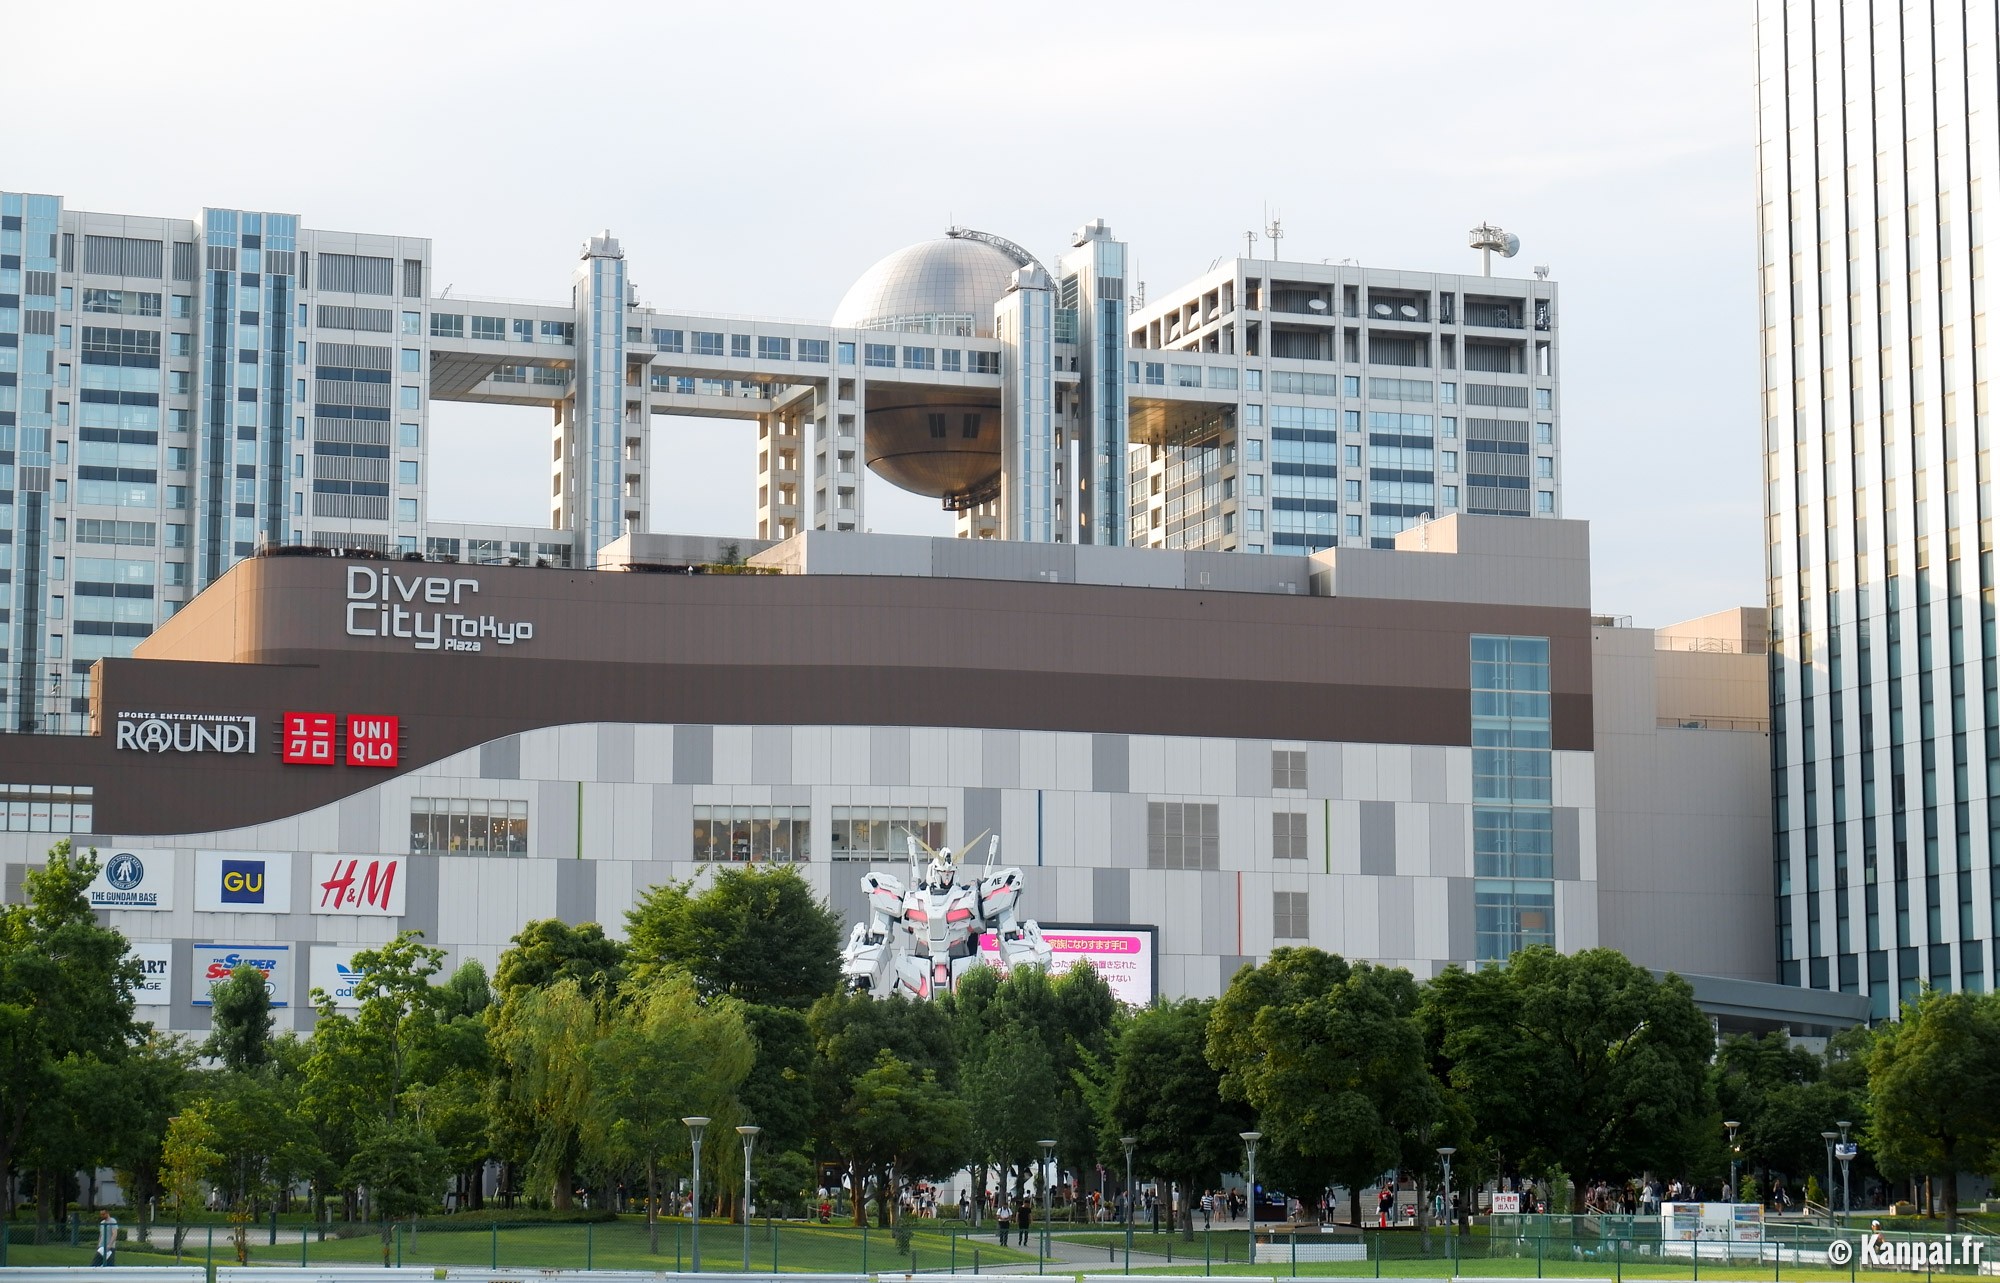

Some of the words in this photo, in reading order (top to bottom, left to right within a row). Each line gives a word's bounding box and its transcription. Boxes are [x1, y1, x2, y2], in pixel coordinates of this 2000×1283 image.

[347, 566, 479, 604] Diver
[346, 602, 441, 650] City
[445, 638, 481, 652] Plaza
[118, 711, 156, 719] SPORTS
[160, 713, 244, 722] ENTERTAINMENT
[353, 721, 389, 739] UNI
[353, 741, 393, 762] QLO
[223, 871, 263, 893] GU
[320, 859, 398, 911] H&M
[91, 891, 105, 901] THE
[106, 892, 138, 902] GUNDAM
[139, 893, 157, 902] BASE
